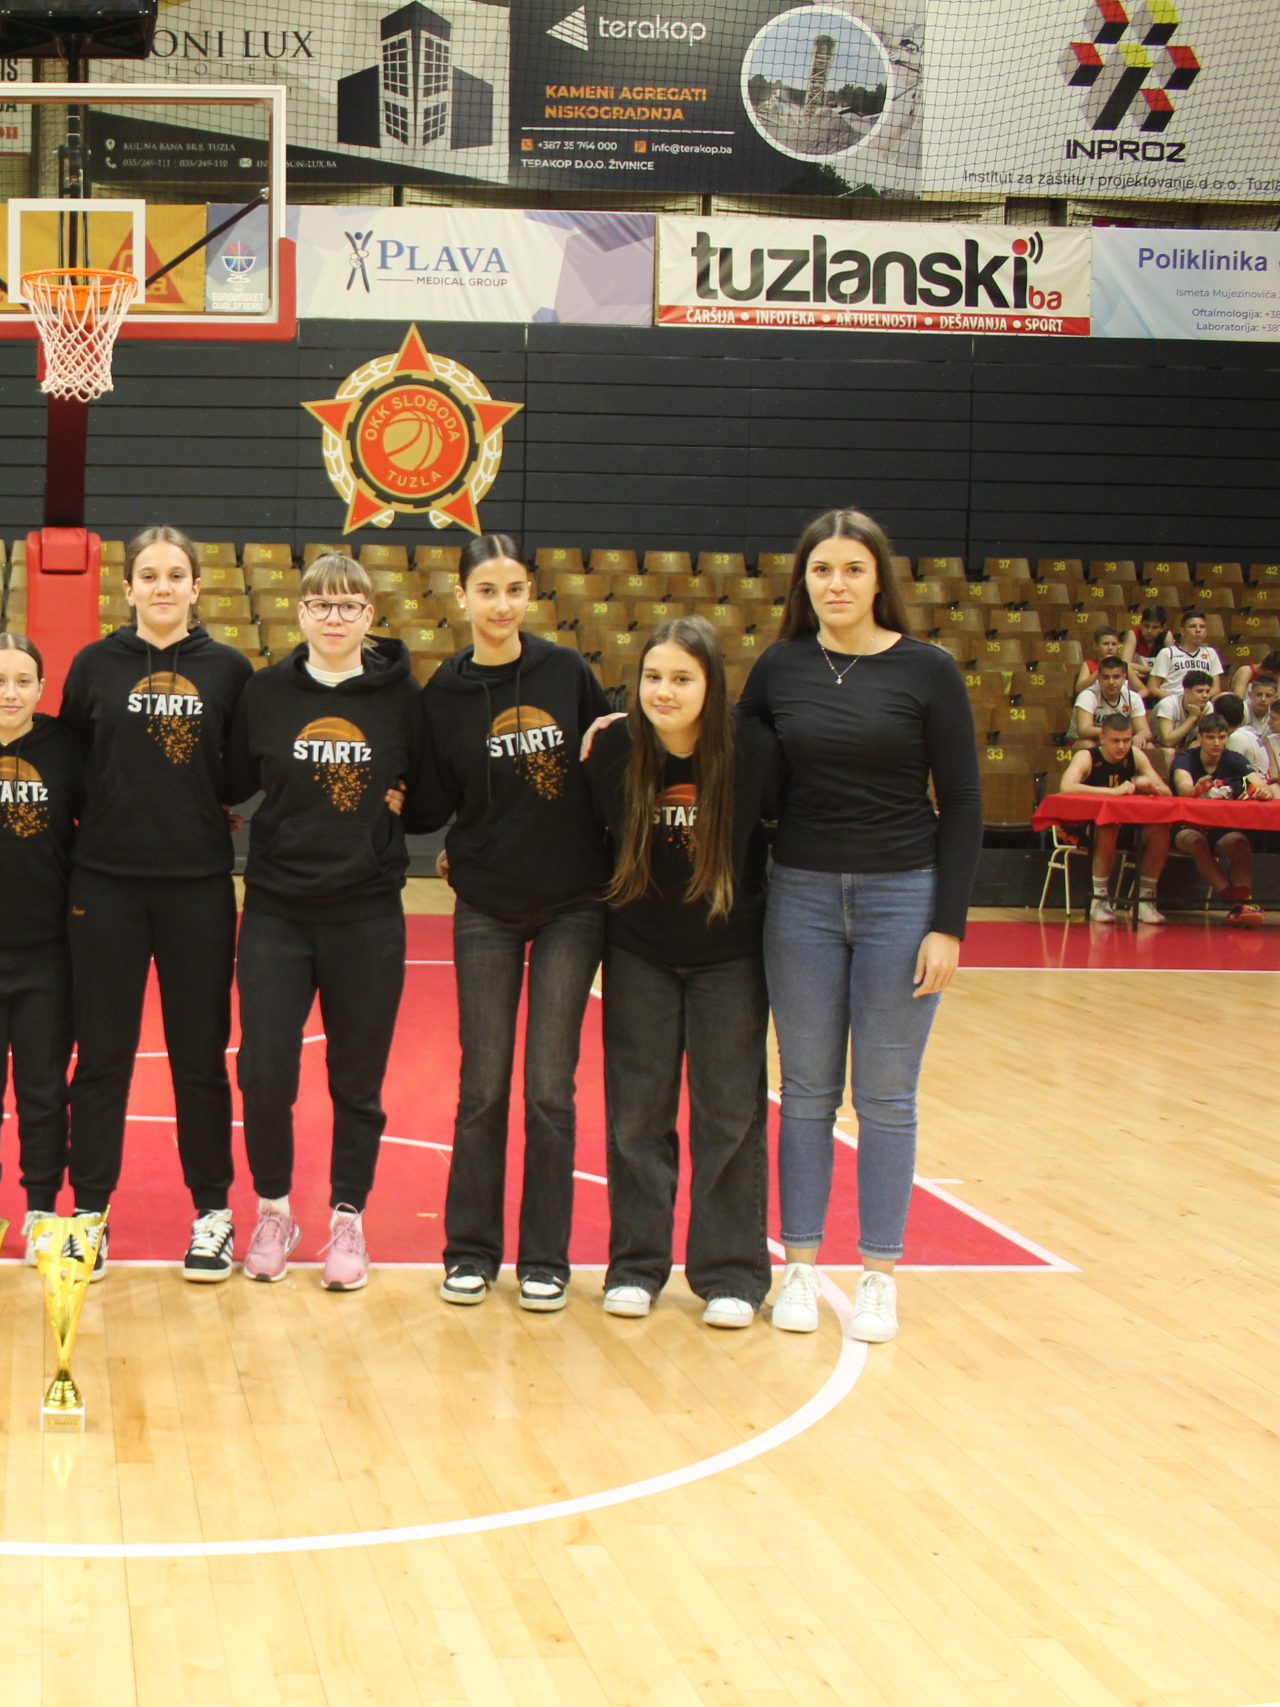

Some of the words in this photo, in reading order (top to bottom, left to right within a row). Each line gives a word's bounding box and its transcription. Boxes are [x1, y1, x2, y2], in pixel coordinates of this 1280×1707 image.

[598, 15, 707, 46] terakop
[243, 30, 315, 59] LUX
[167, 62, 280, 77] HOTEL
[544, 83, 616, 100] KAMENI
[618, 85, 708, 102] AGREGATI
[544, 104, 685, 121] NISKOGRADNJA
[564, 141, 575, 151] 35
[576, 141, 596, 151] 764
[596, 141, 618, 152] 000
[1065, 139, 1186, 163] INPROZ
[521, 159, 573, 170] TERAKOP
[574, 159, 607, 170] D.O.O.
[608, 158, 655, 171] ŽIVINICE
[963, 169, 1014, 184] Institut
[1017, 173, 1033, 185] za
[1038, 170, 1086, 186] zaštitu
[1089, 173, 1095, 186] i
[1097, 173, 1195, 192] projektovanje
[376, 239, 510, 274] PLAVA
[1138, 247, 1268, 272] Poliklinika
[690, 230, 1029, 310] tuzlanski
[1028, 285, 1063, 311] ba
[416, 276, 466, 286] MEDICAL
[468, 277, 509, 287] GROUP
[1175, 288, 1211, 298] Ismeta
[1212, 289, 1277, 300] Mujezinovića
[686, 305, 736, 325] ČARŠIJA
[755, 309, 816, 326] INFOTEKA
[835, 311, 918, 329] AKTUELNOSTI
[939, 313, 1008, 332] DEŠAVANJA
[1024, 316, 1064, 334] SPORT
[1196, 322, 1260, 333] Laboratorija:
[364, 405, 392, 441] OKK
[391, 394, 462, 443] SLOBODA
[386, 469, 443, 489] TUZLA
[998, 559, 1011, 569] 37
[1104, 561, 1118, 572] 39
[1156, 562, 1170, 573] 40
[1211, 564, 1223, 575] 41
[270, 570, 283, 580] 24
[1265, 565, 1279, 576] 42
[628, 576, 642, 587] 30
[688, 577, 700, 588] 31
[740, 578, 753, 589] 32
[1036, 584, 1049, 595] 37
[1091, 587, 1105, 598] 38
[1145, 587, 1159, 598] 39
[1199, 588, 1213, 599] 40
[1257, 590, 1268, 600] 41
[276, 597, 289, 608] 24
[404, 599, 419, 610] 26
[593, 602, 608, 614] 29
[652, 604, 667, 615] 30
[714, 605, 727, 617] 31
[950, 611, 964, 622] 35
[1007, 612, 1021, 624] 36
[1076, 613, 1090, 624] 37
[1246, 616, 1261, 628] 40
[224, 626, 239, 637] 23
[420, 629, 435, 641] 26
[616, 633, 631, 645] 29
[742, 635, 755, 647] 31
[986, 641, 1001, 653] 35
[1046, 642, 1061, 653] 36
[1236, 646, 1250, 657] 39
[965, 674, 981, 686] 34
[1030, 674, 1045, 686] 35
[1009, 708, 1026, 720] 34
[986, 747, 1004, 760] 33
[1055, 749, 1073, 761] 34
